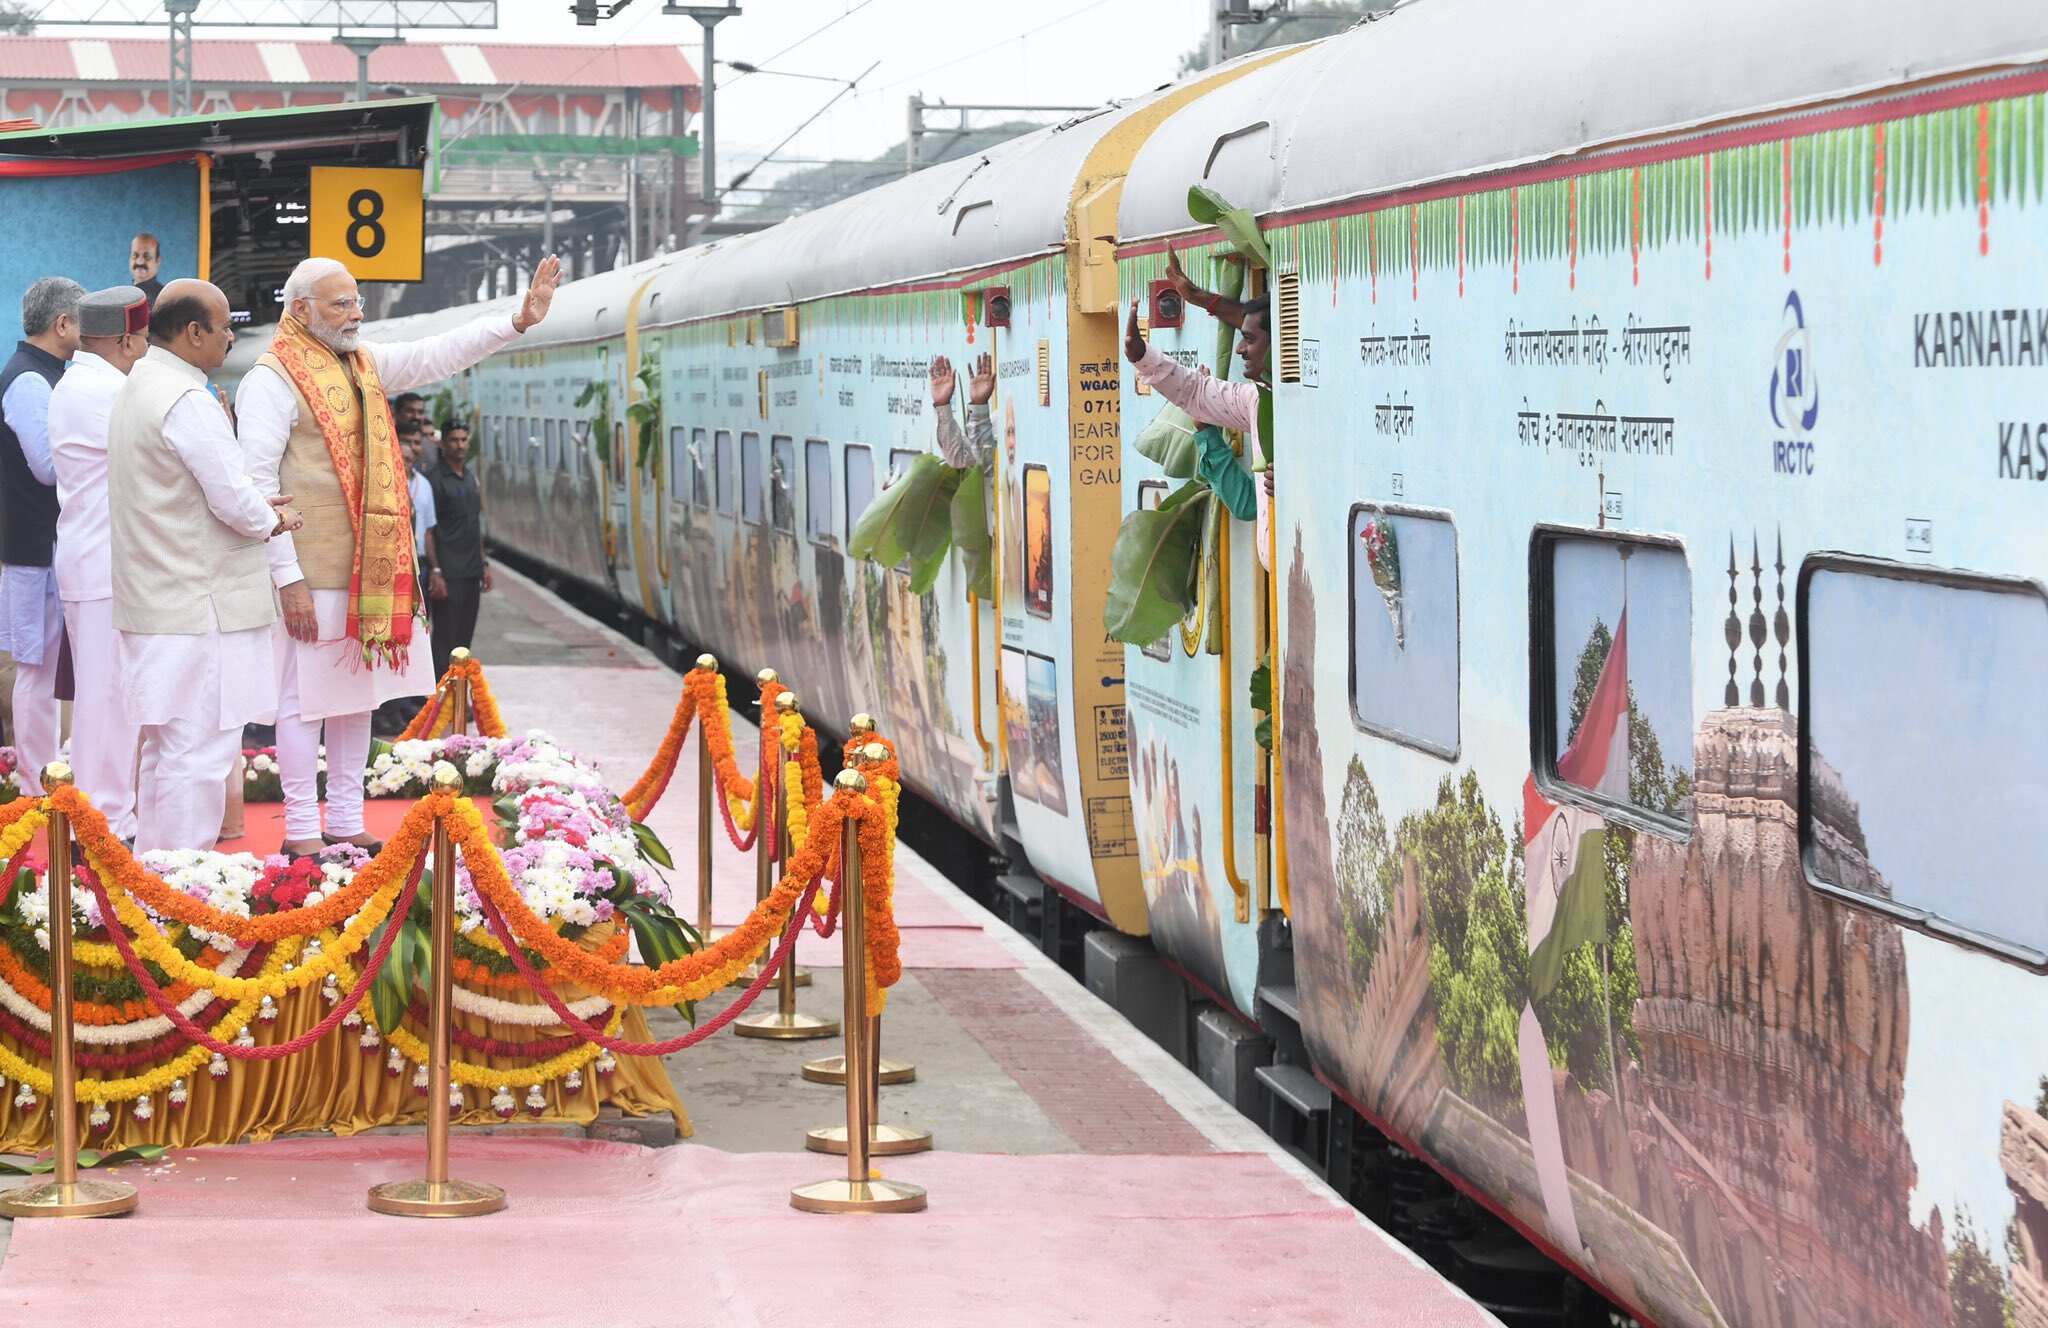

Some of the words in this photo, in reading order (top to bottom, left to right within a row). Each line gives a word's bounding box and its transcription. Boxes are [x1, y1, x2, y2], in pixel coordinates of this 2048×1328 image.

[346, 188, 386, 258] 8
[1410, 317, 1431, 366] गौरव
[1505, 317, 1516, 366] श्री
[1582, 313, 1608, 375] मंदिर
[1914, 308, 2048, 368] KARNATAK
[1080, 380, 1120, 391] WGAC
[1375, 391, 1391, 435] काशी
[1393, 389, 1414, 443] दर्शन
[1517, 396, 1541, 446] कोच
[1620, 416, 1675, 456] शयनयान
[1073, 445, 1114, 460] FOR
[1773, 440, 1815, 475] IRCTC
[1998, 422, 2048, 481] KAS
